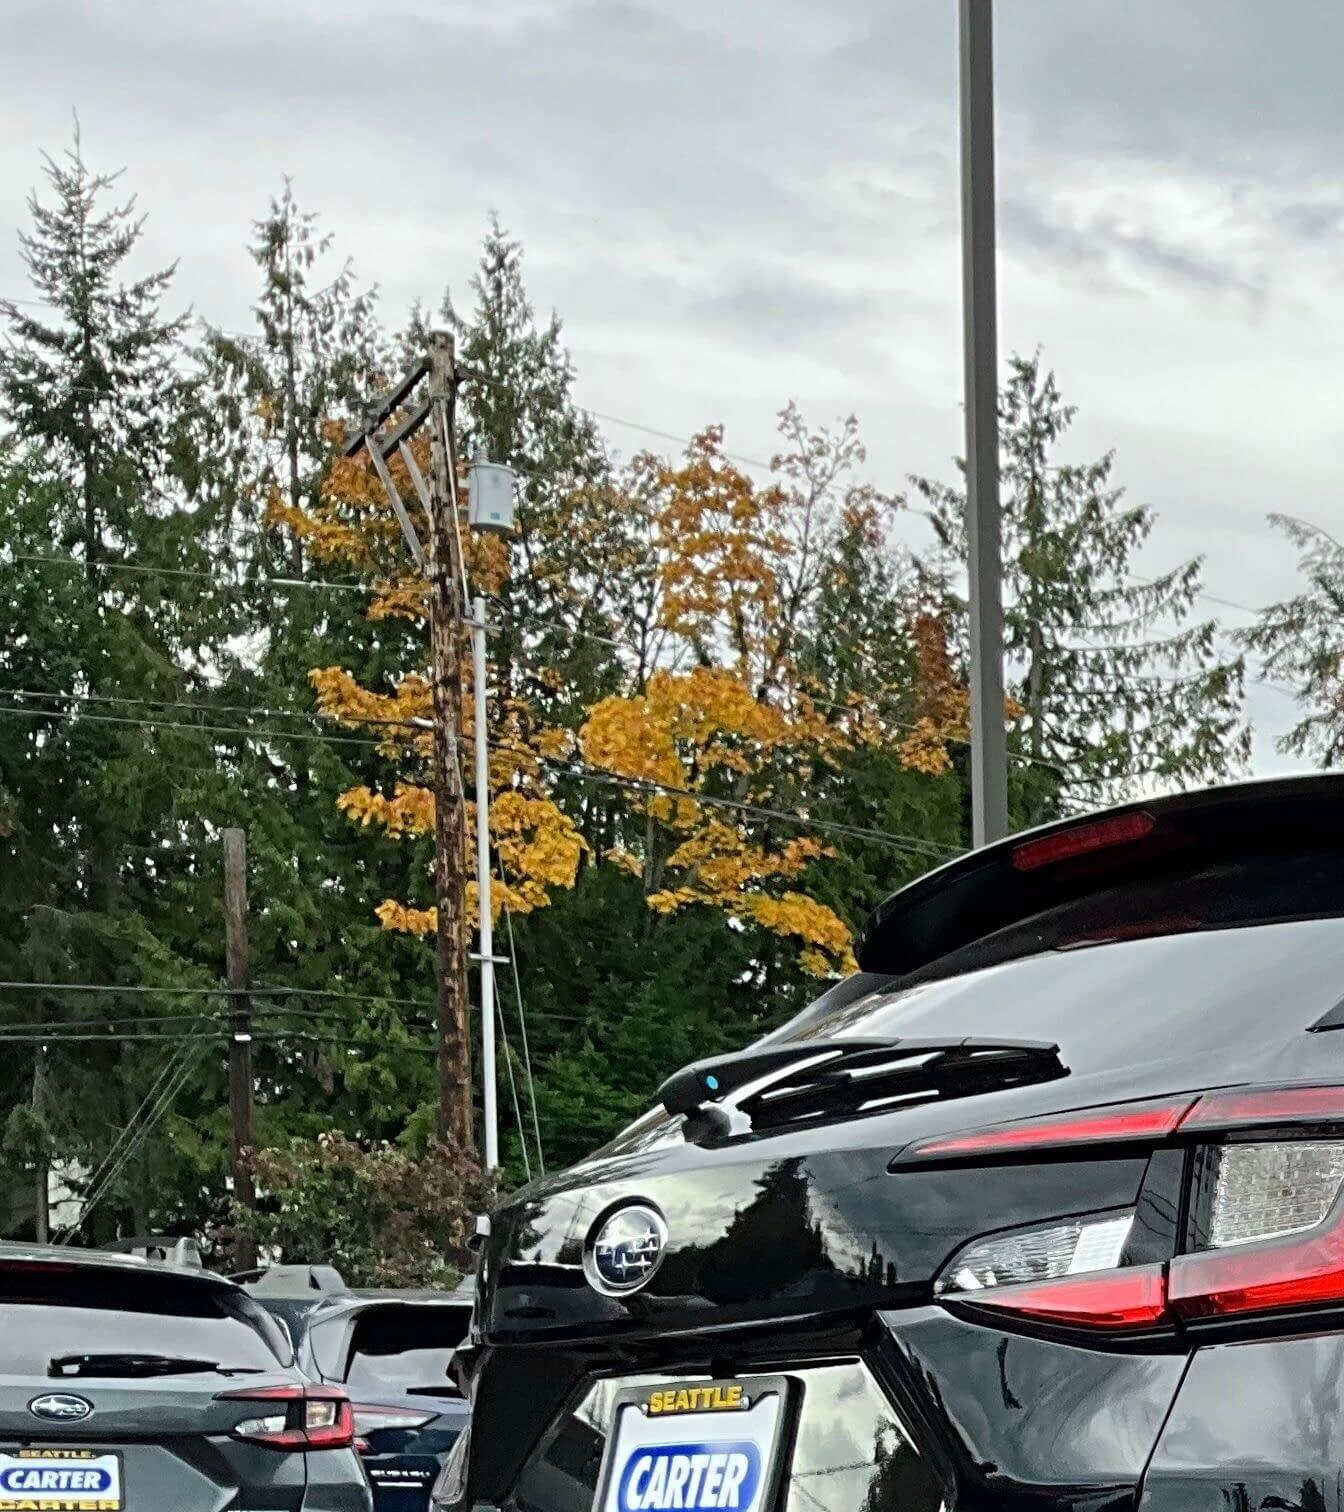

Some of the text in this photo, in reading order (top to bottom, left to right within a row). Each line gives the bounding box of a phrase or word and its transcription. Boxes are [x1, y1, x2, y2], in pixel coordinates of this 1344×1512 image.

[650, 1386, 743, 1413] SEATTLE
[20, 1450, 91, 1458] SEATTLE
[7, 1470, 102, 1489] CARTER
[626, 1453, 749, 1511] CARTER
